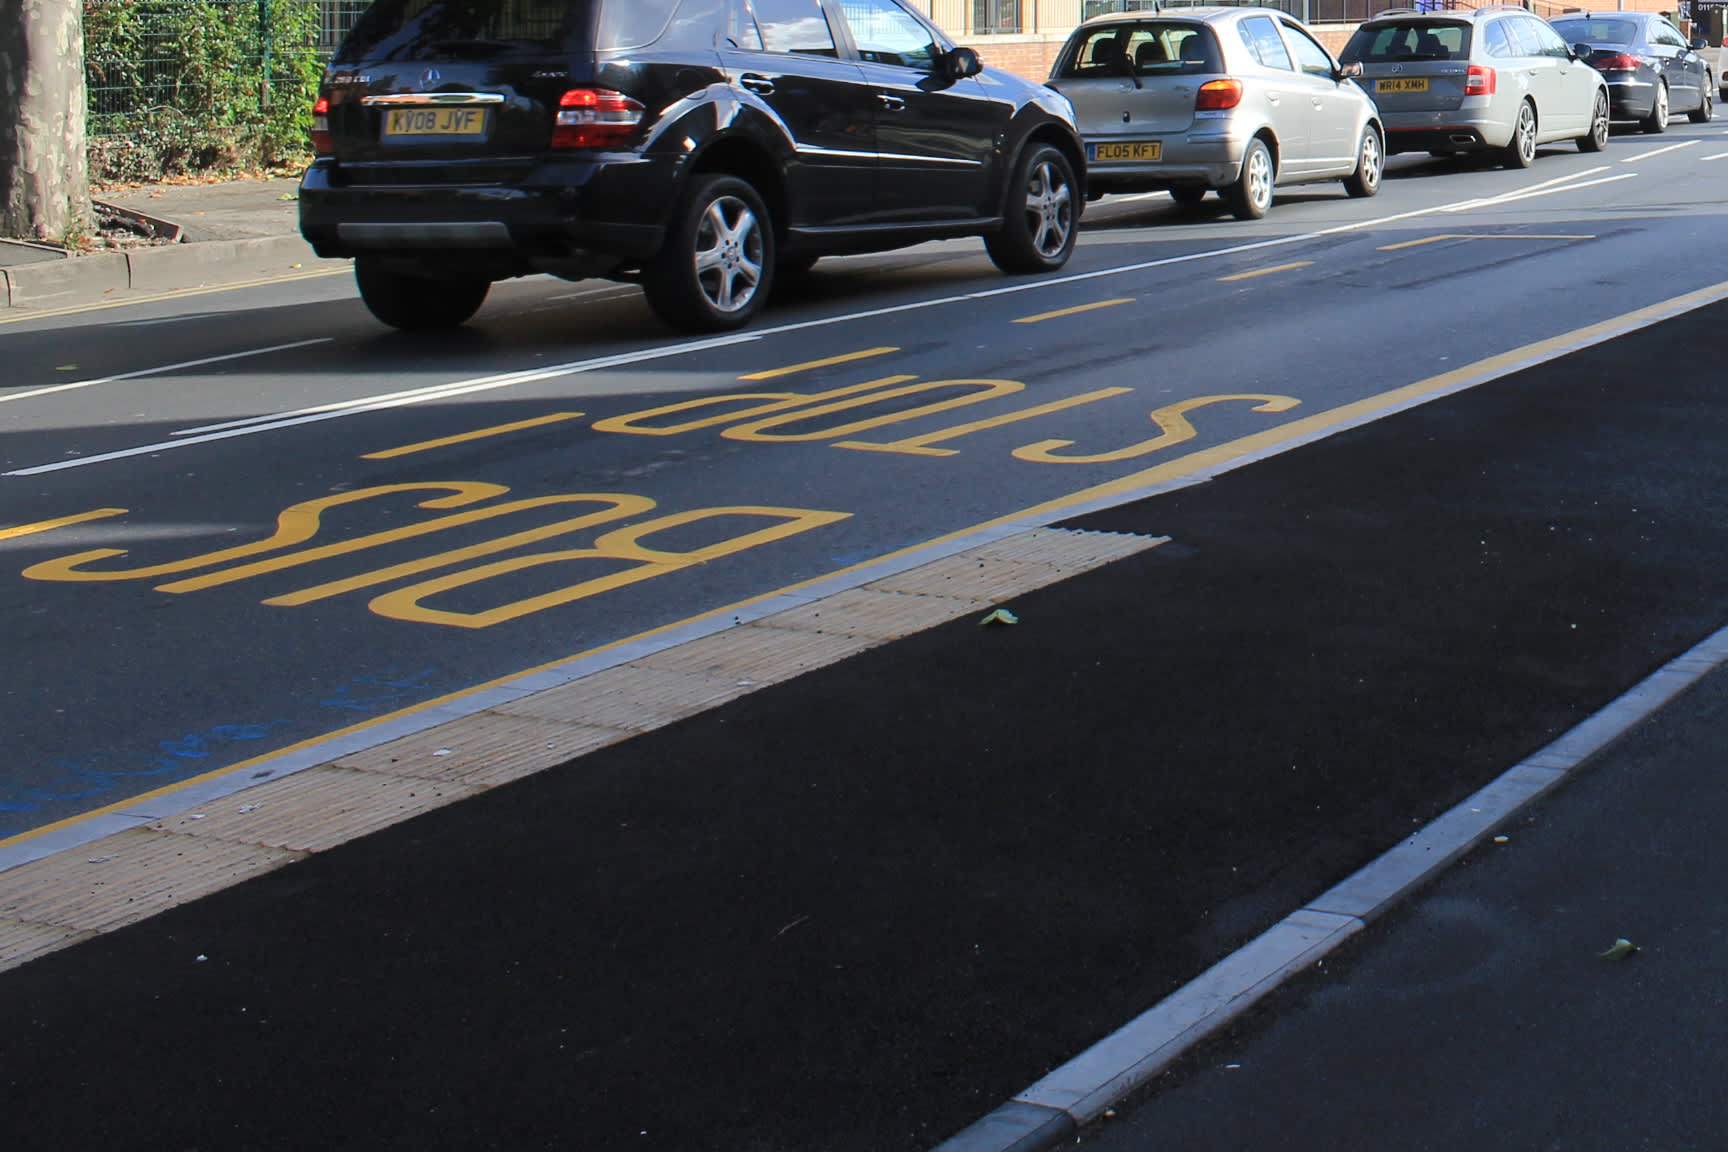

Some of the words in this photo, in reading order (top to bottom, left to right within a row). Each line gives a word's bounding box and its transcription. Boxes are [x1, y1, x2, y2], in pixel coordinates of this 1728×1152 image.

[1379, 80, 1401, 91] WR14
[1405, 79, 1425, 90] XMH
[1096, 144, 1130, 159] FL05
[1133, 143, 1158, 158] KFT
[591, 374, 1302, 464] STOP
[21, 480, 854, 629] BUS
